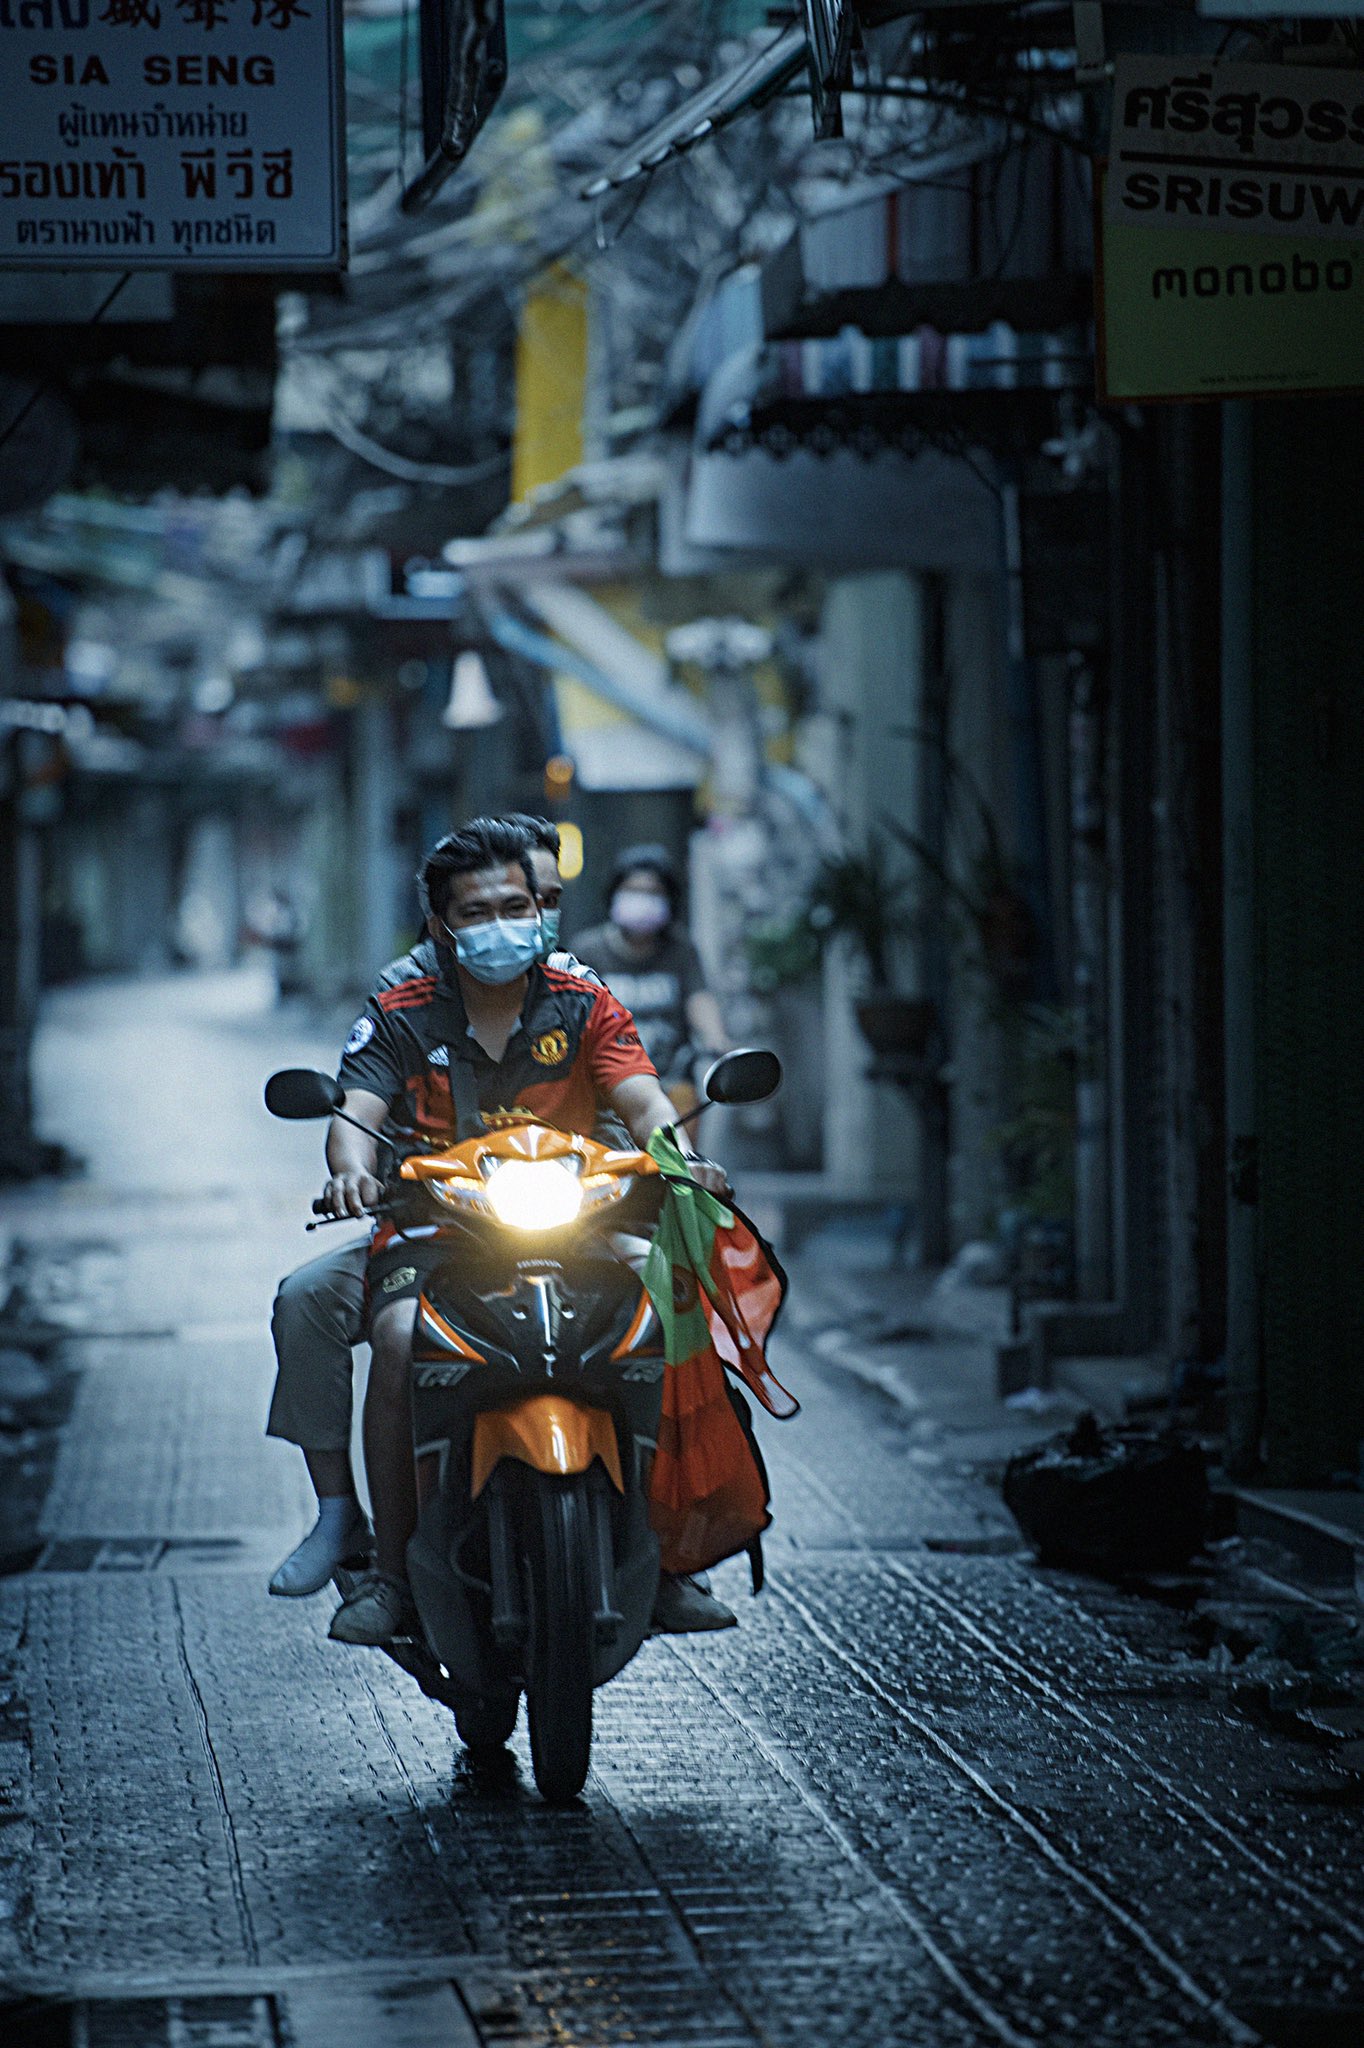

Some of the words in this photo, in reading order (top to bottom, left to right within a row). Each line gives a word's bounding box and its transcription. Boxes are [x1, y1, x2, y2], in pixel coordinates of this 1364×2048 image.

[29, 54, 109, 85] SIA
[143, 54, 276, 86] SENG
[57, 103, 249, 148] ผู้แทนจำหน่าย
[0, 147, 146, 200] รองเท้า
[16, 211, 155, 245] ตรานางฟ้า
[171, 213, 276, 254] ทุกชนิด
[1152, 252, 1354, 299] monobo
